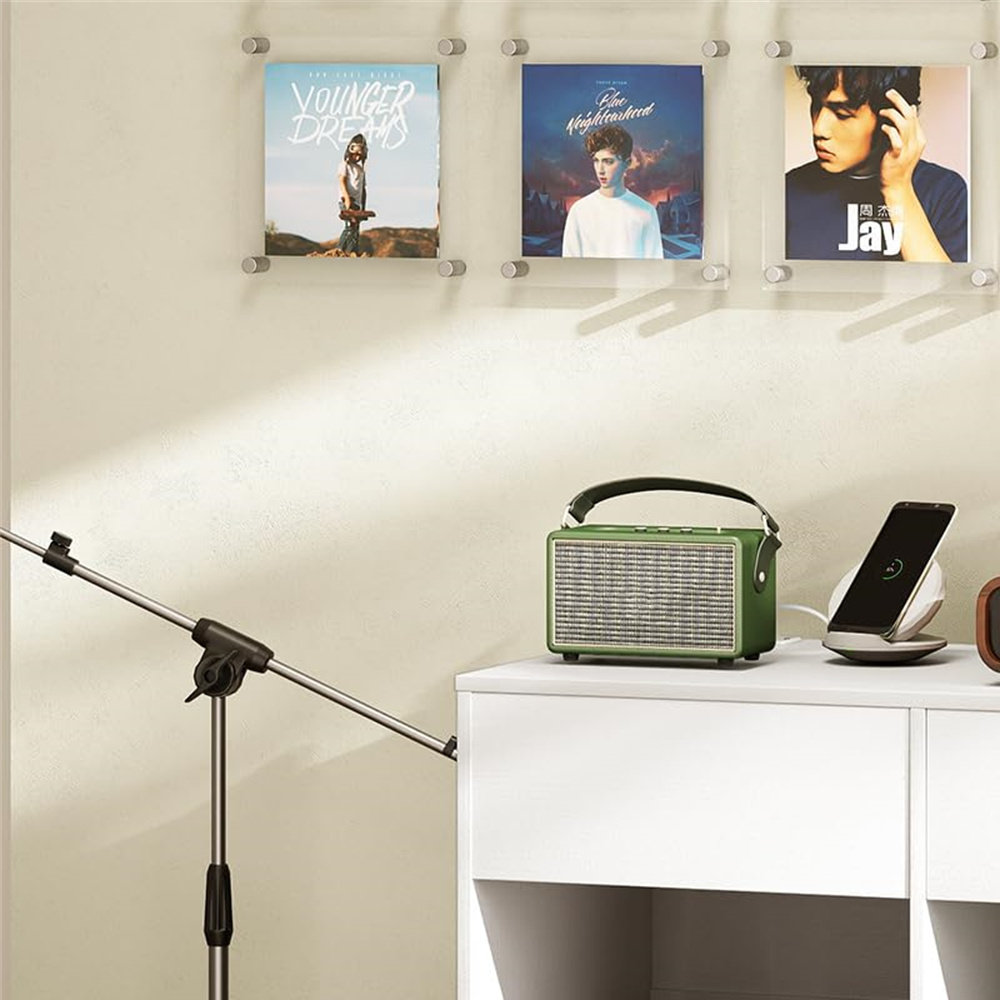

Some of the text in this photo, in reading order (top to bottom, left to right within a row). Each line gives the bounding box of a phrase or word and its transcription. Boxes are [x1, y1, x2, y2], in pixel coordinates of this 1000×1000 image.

[291, 81, 415, 133] YOUNGER
[595, 87, 628, 110] Blue
[287, 113, 406, 151] DREAMS
[566, 102, 655, 135] Neighbourhood
[838, 203, 904, 256] Jay
